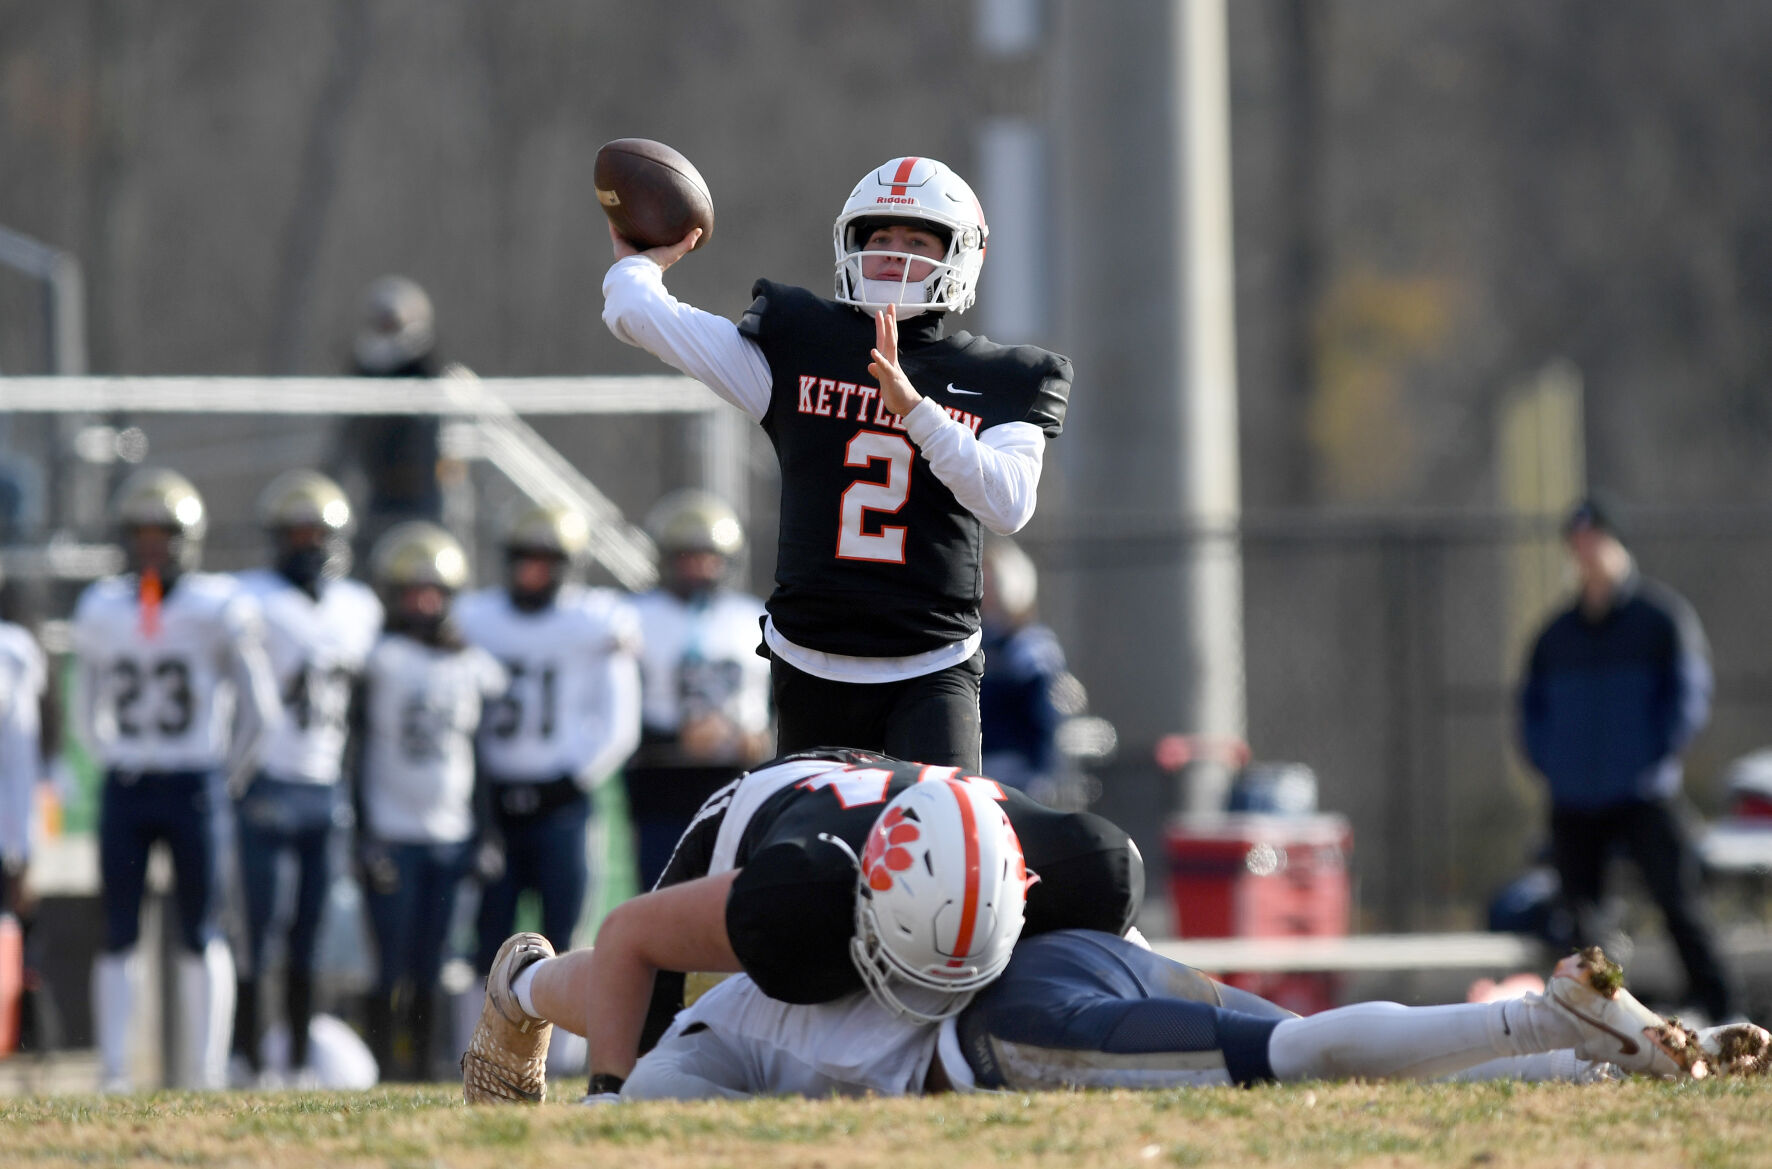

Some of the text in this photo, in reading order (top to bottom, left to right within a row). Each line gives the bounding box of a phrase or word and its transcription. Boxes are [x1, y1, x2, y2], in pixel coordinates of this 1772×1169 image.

[876, 195, 914, 205] Riddell
[835, 428, 915, 564] 2
[111, 657, 195, 738] 23
